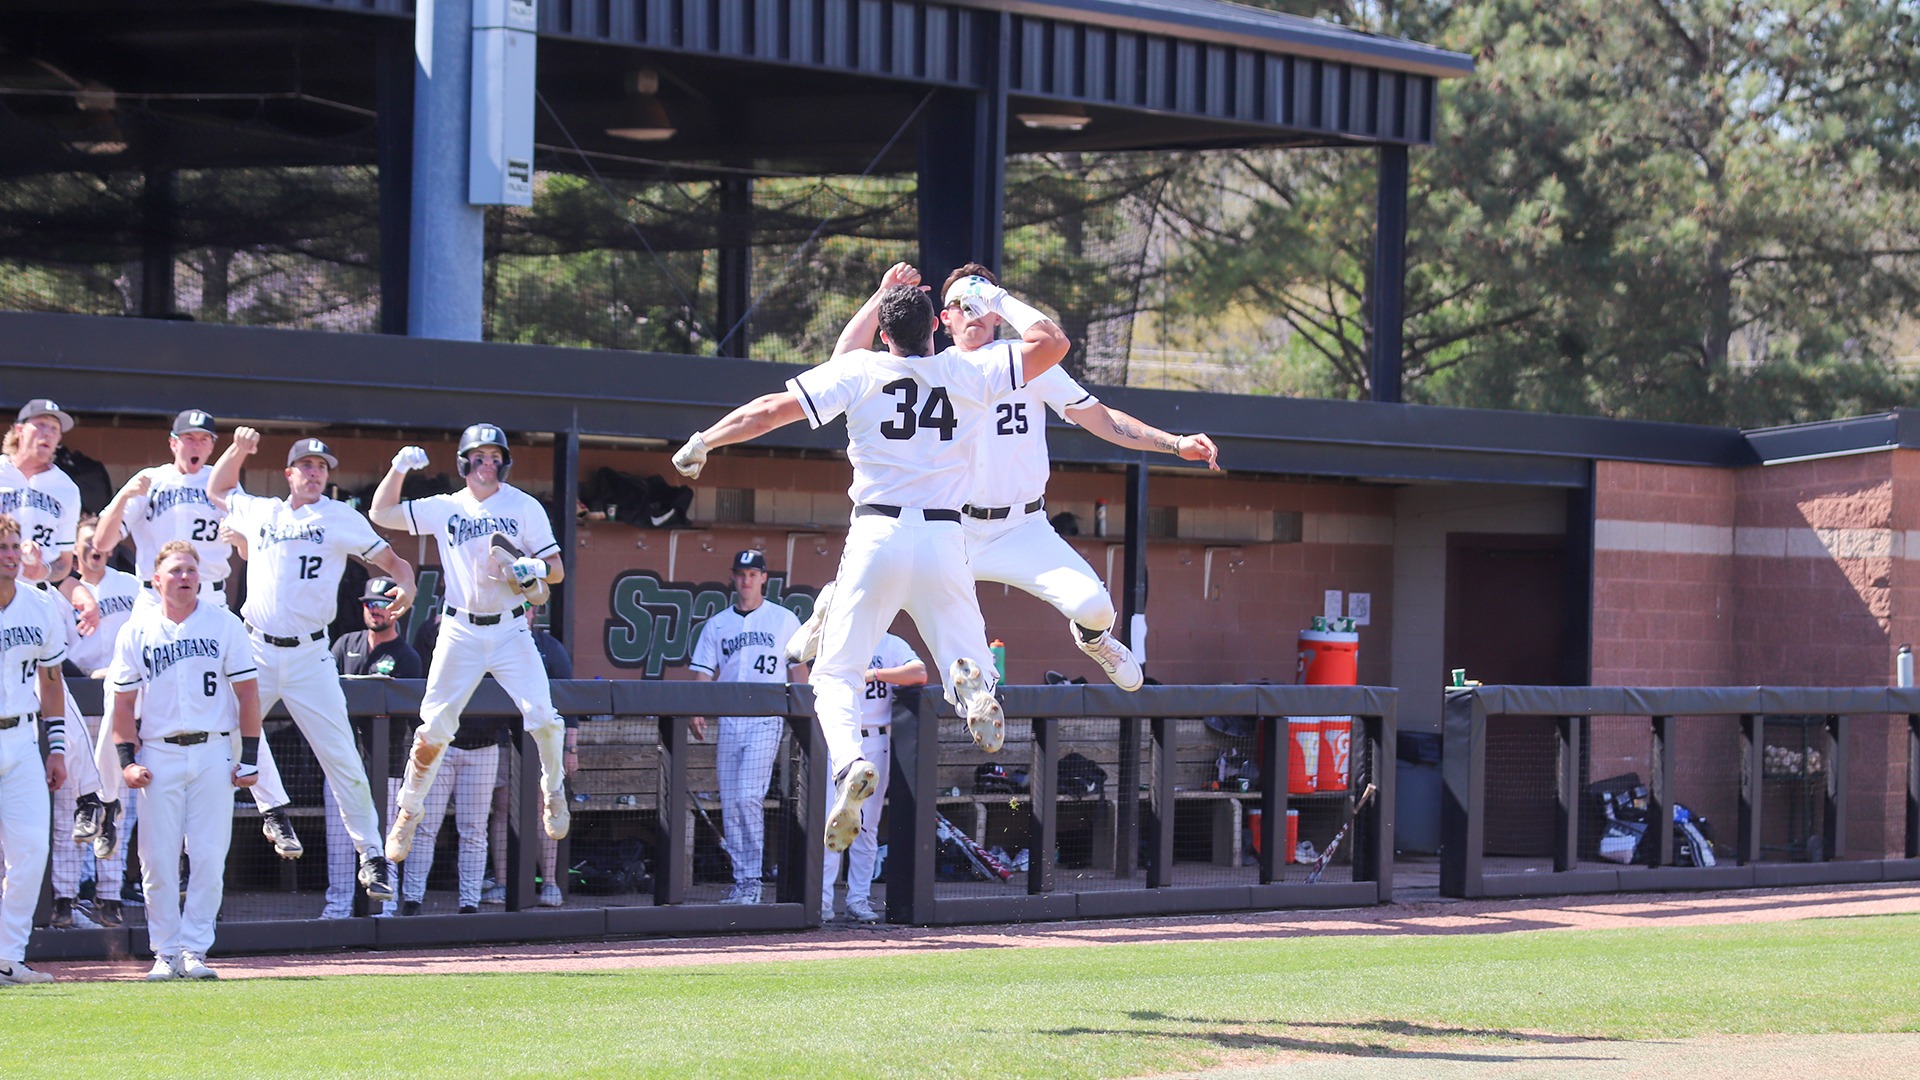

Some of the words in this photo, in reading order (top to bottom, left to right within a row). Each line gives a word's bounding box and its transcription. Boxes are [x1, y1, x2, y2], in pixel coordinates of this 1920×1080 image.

[189, 412, 205, 426] U
[881, 377, 958, 441] 34
[996, 403, 1029, 435] 25
[309, 439, 324, 452] U
[481, 428, 497, 442] U
[191, 518, 219, 542] 23
[446, 513, 519, 548] SPARTANS
[299, 555, 322, 579] 12
[740, 552, 755, 564] U
[371, 579, 387, 593] U
[720, 631, 775, 664] SPARTANS
[142, 638, 220, 682] SPARTANS
[754, 655, 778, 675] 43
[203, 671, 217, 697] 6
[865, 680, 887, 700] 28
